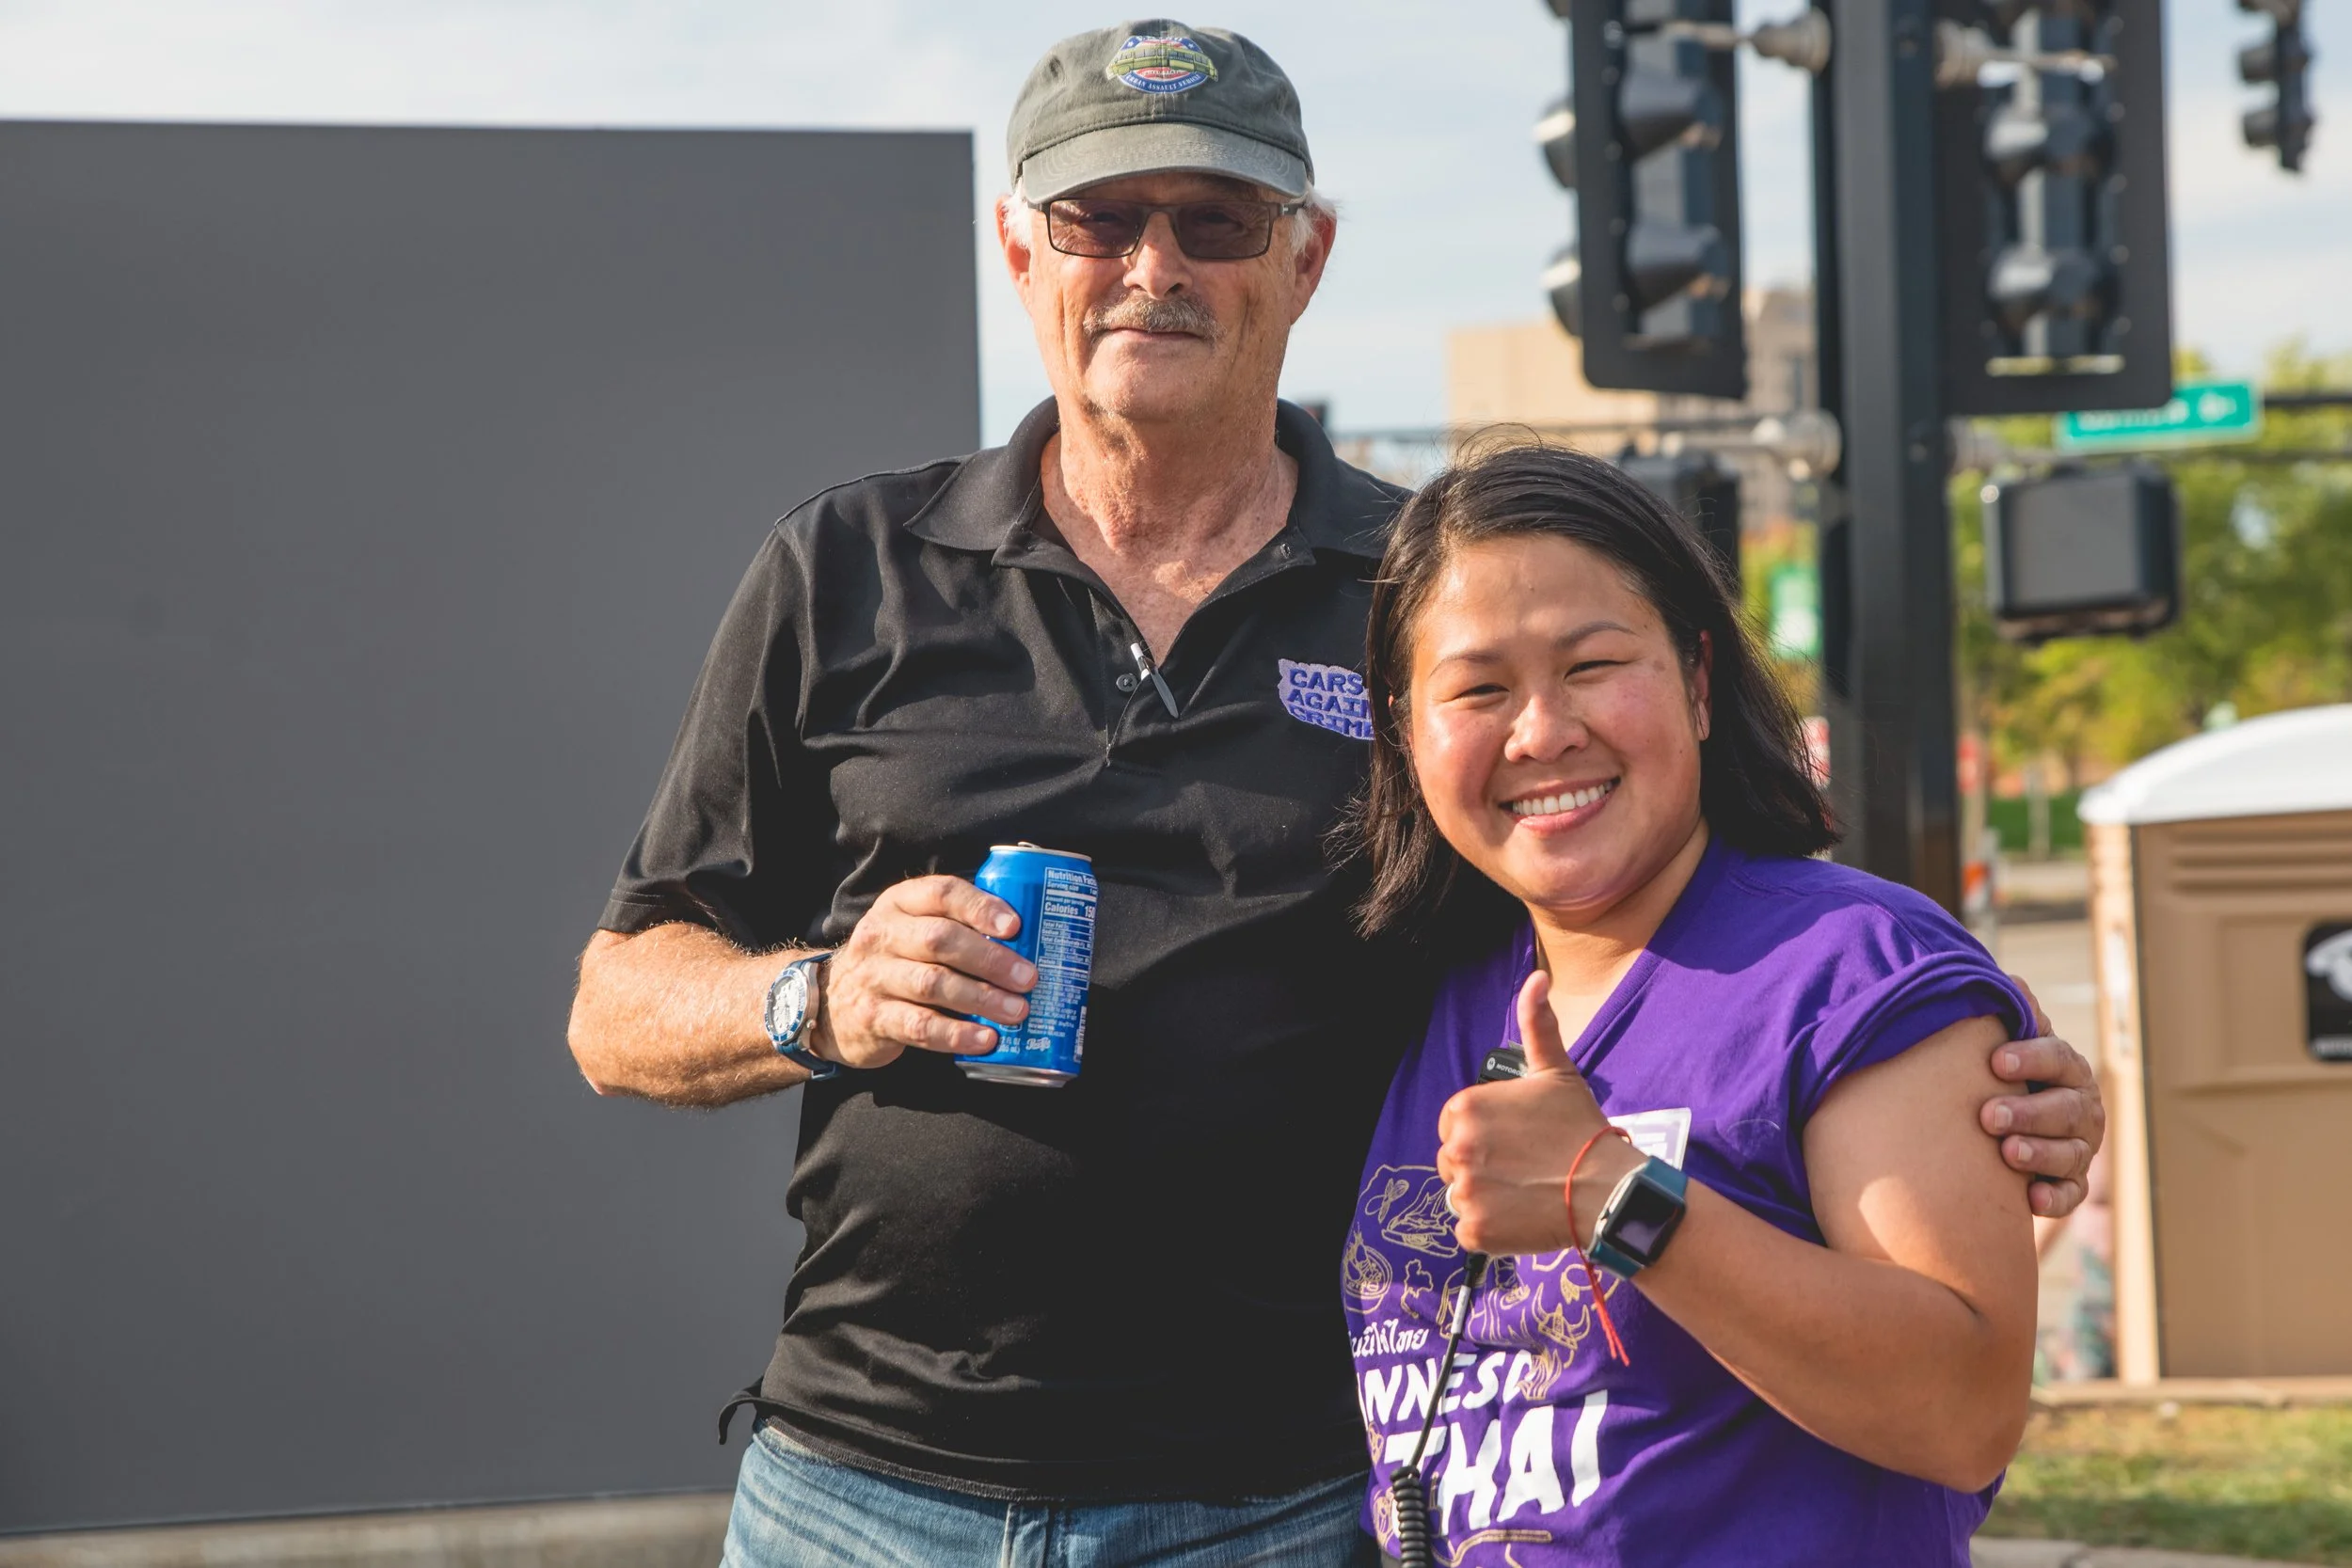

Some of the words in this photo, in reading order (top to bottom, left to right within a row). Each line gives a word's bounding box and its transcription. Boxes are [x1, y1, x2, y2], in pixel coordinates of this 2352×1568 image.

[1148, 82, 1177, 91] ASSAULT
[1289, 668, 1364, 695] CARS
[1047, 869, 1083, 883] Nutrition
[1047, 881, 1069, 891] Serving
[1044, 902, 1079, 915] Calories
[1085, 905, 1095, 919] 150
[1383, 1389, 1609, 1537] THAI
